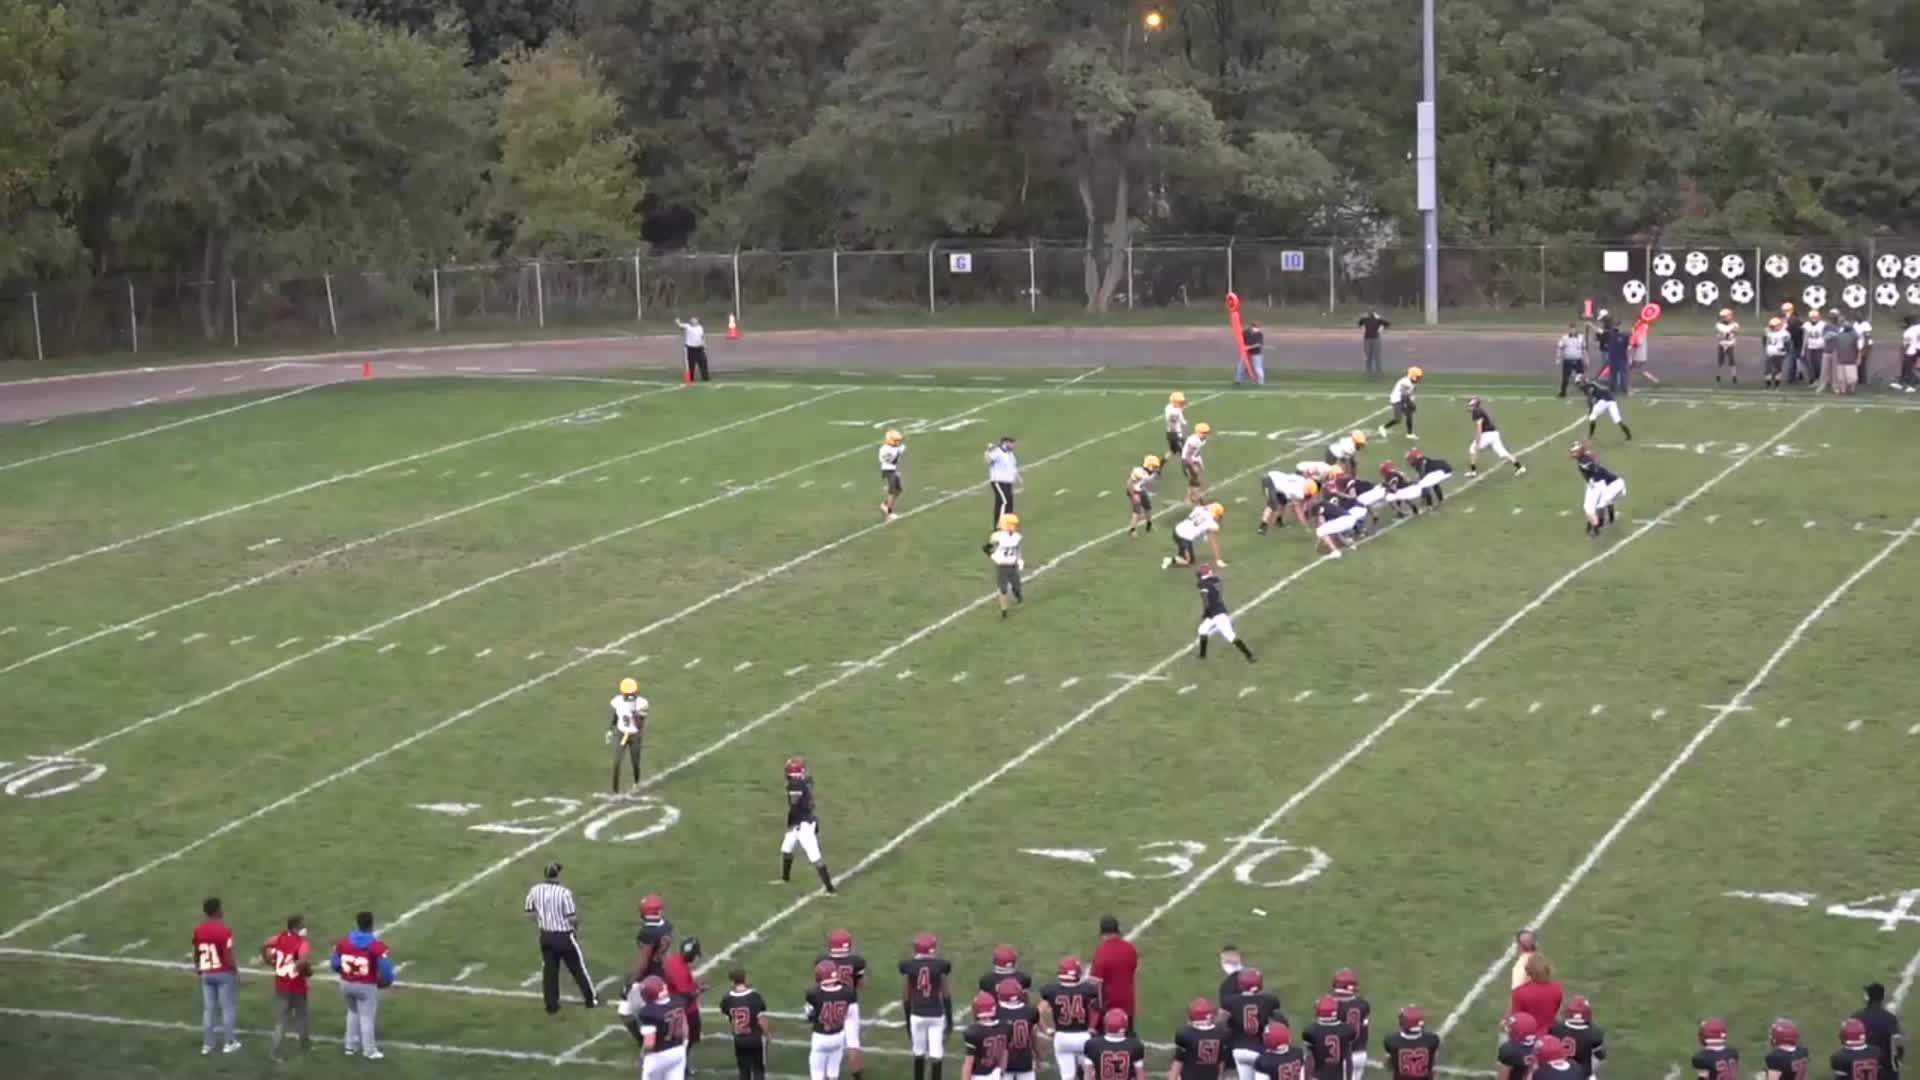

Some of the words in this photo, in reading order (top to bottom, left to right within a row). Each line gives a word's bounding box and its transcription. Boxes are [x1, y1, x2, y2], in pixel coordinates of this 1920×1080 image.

[1284, 254, 1301, 268] 10
[1103, 840, 1333, 887] 30
[198, 943, 222, 971] 21
[340, 954, 369, 976] 53
[917, 966, 932, 998] 4
[1055, 995, 1086, 1025] 34
[1324, 1034, 1340, 1065] 3
[1101, 1050, 1130, 1080] 63
